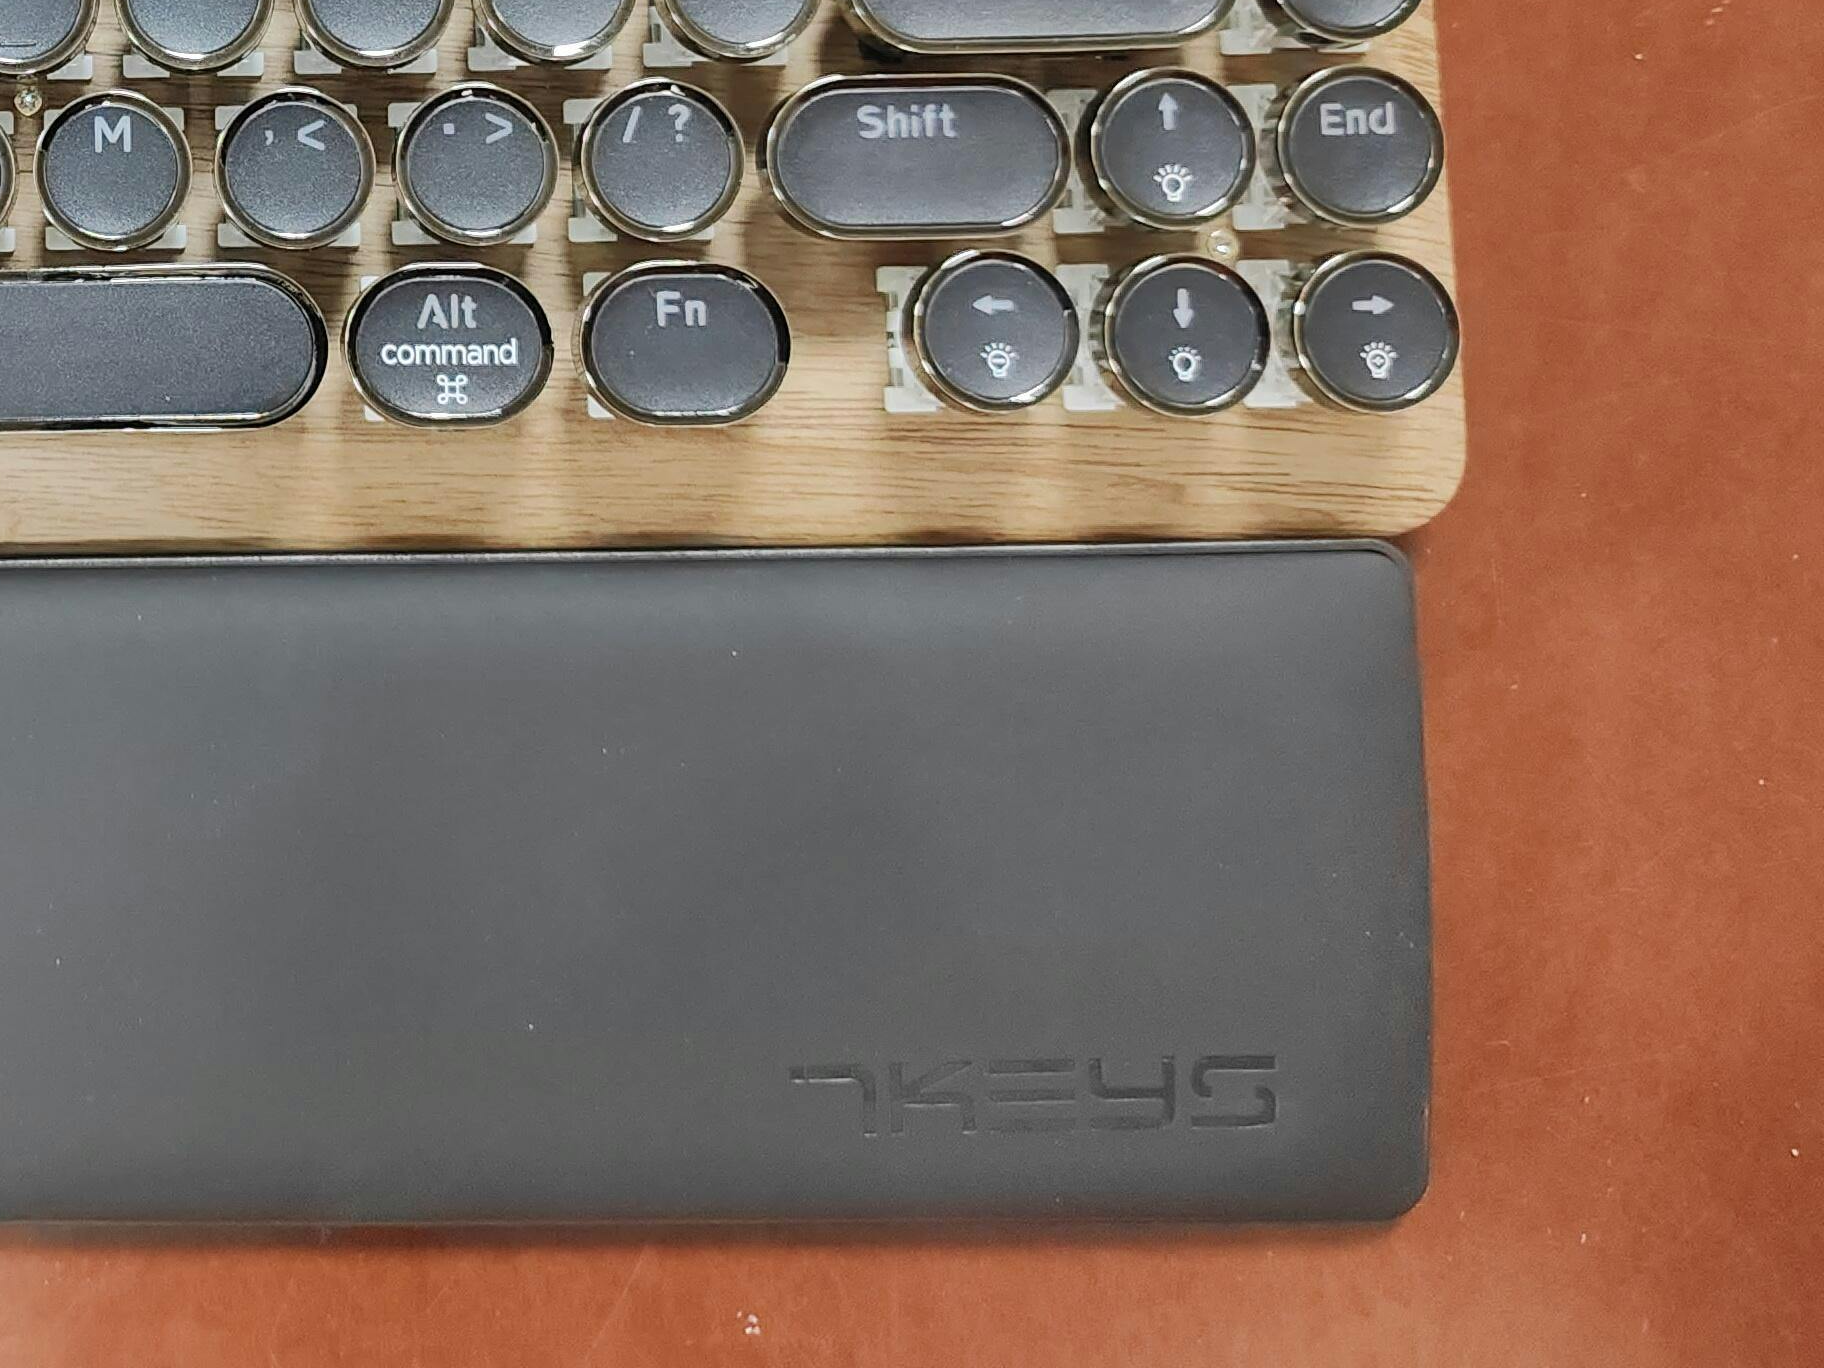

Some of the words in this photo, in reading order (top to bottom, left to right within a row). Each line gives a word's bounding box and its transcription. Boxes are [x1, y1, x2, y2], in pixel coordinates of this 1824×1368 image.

[95, 116, 131, 153] M
[857, 105, 956, 138] Shift
[1321, 102, 1396, 135] End
[417, 294, 476, 329] Alt
[656, 291, 706, 326] Fn
[381, 338, 517, 365] command
